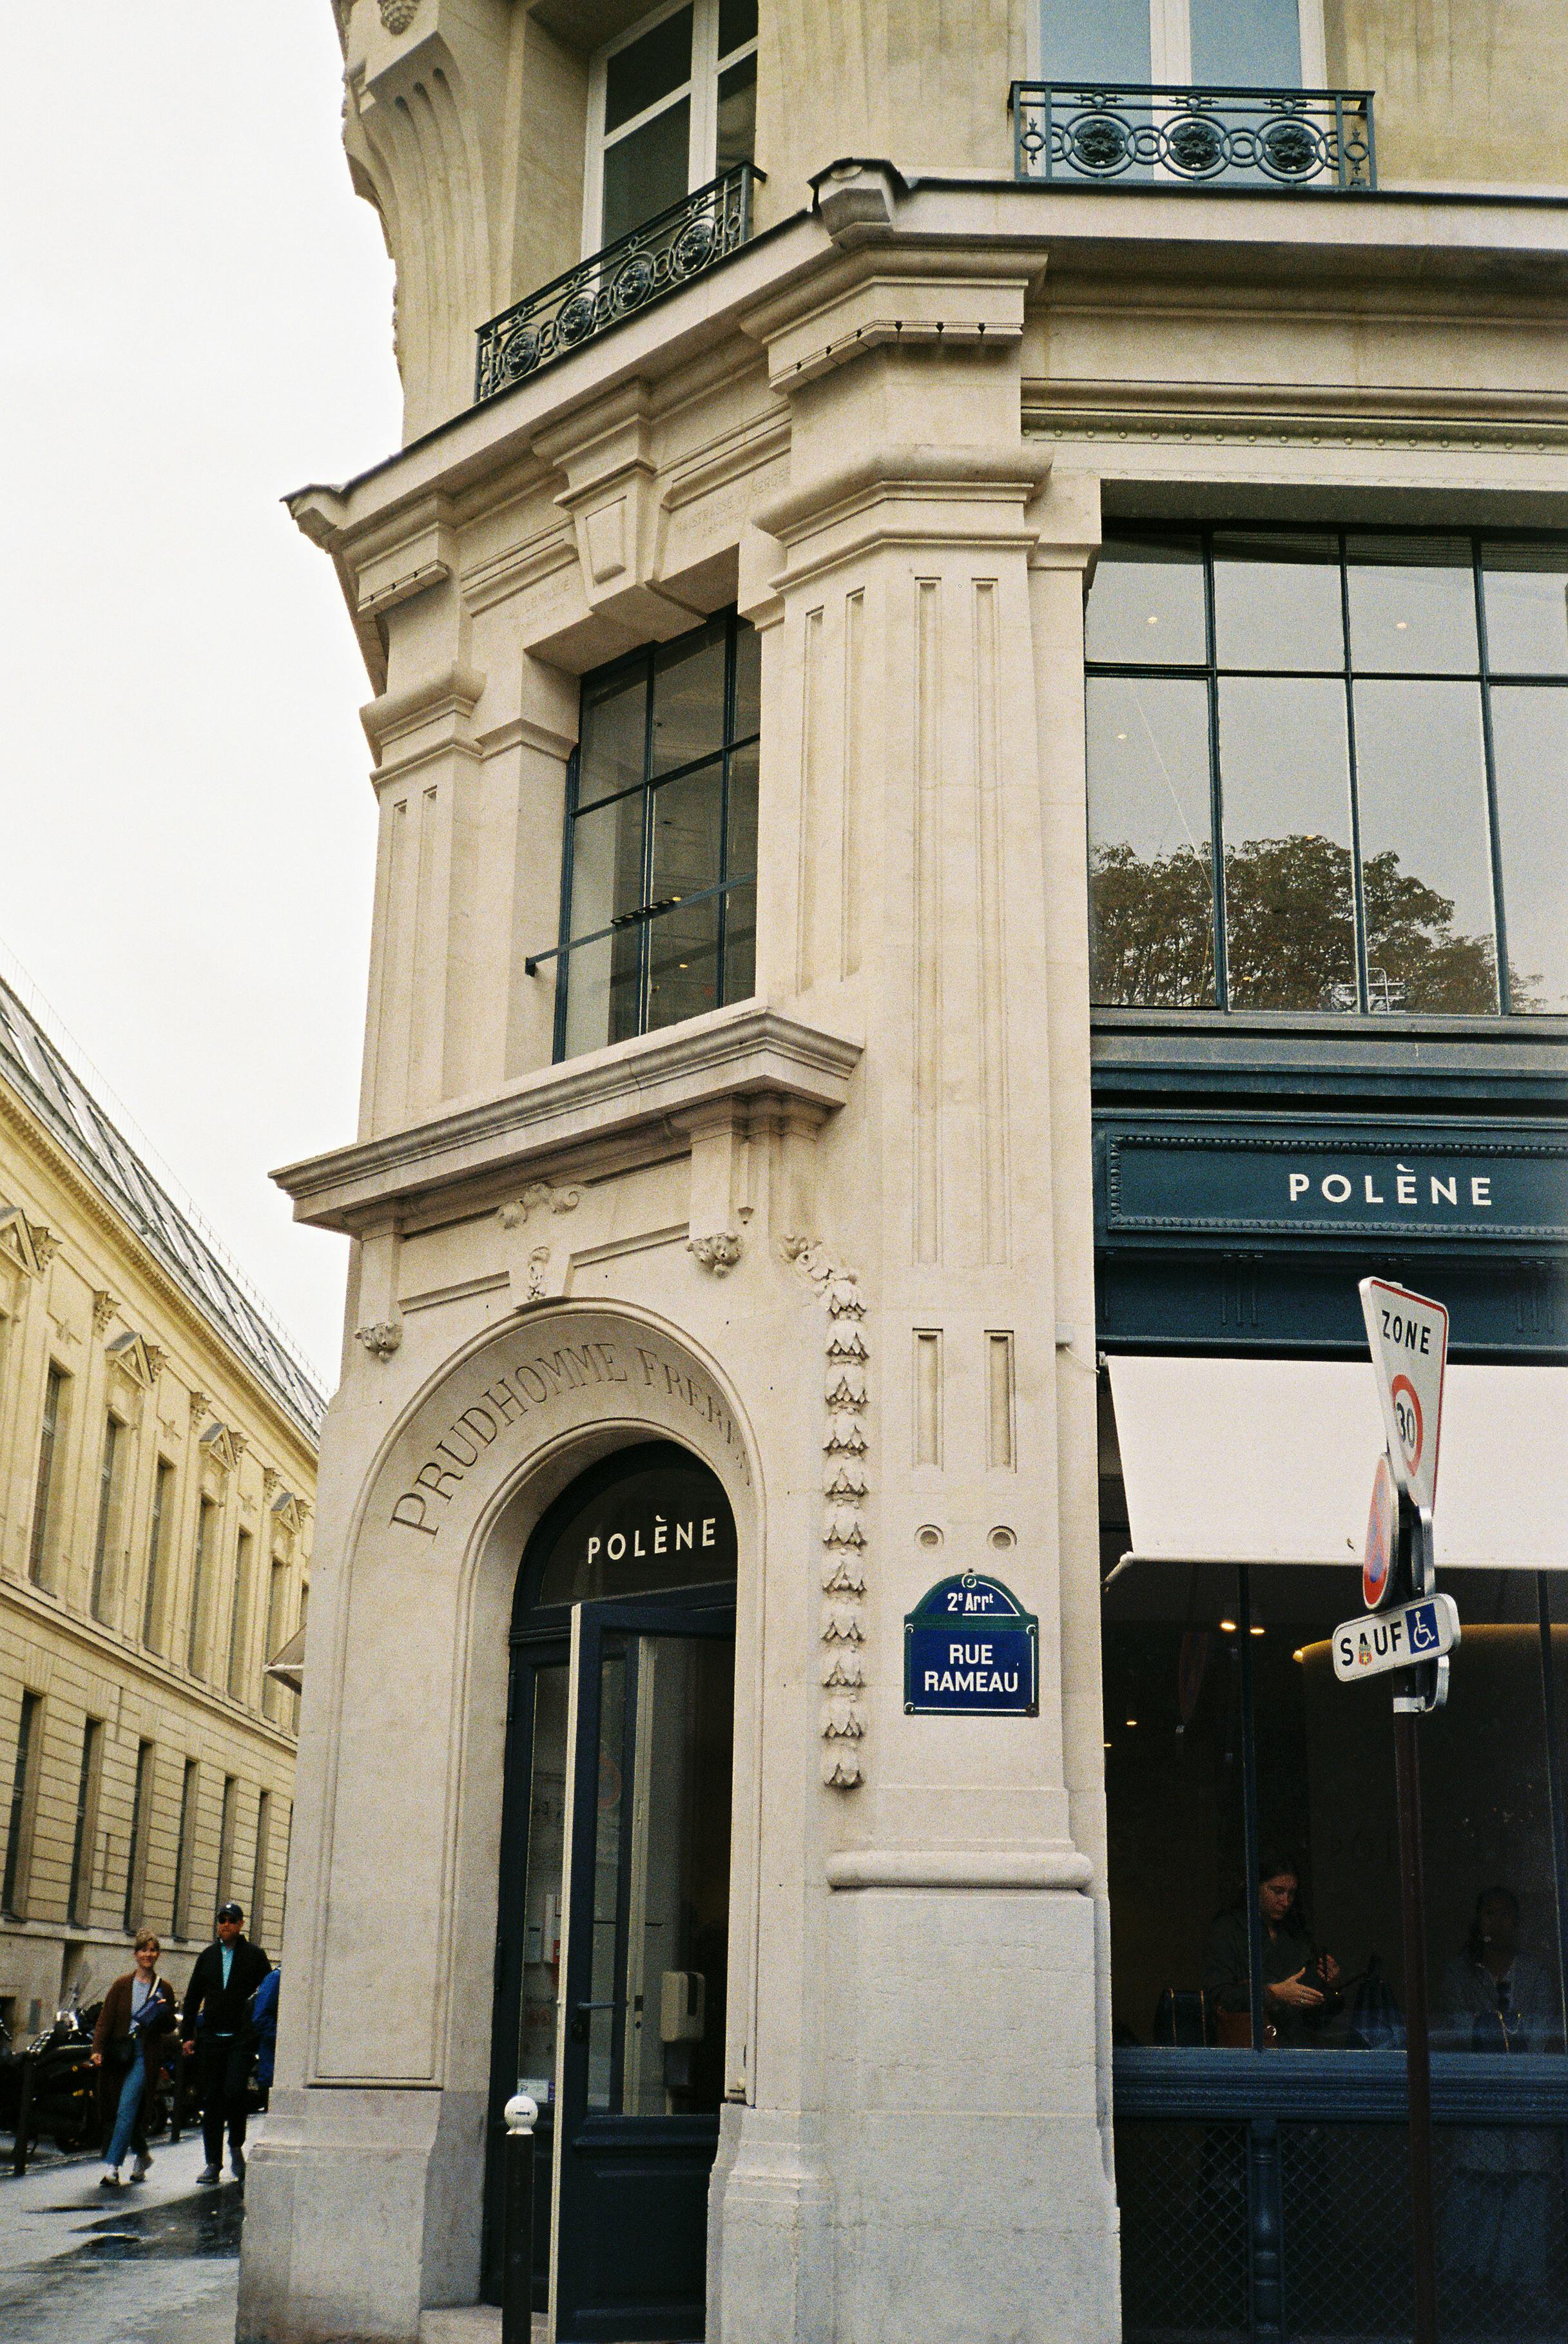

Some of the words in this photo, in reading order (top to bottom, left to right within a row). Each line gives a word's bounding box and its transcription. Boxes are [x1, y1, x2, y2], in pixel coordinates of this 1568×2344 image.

[1290, 1163, 1492, 1206] POLÈNE
[1382, 1310, 1431, 1355] ZONE
[388, 1343, 628, 1543] PRUDHOMME
[635, 1347, 751, 1486] FRER
[1397, 1401, 1415, 1449] 30
[588, 1515, 715, 1564] POLÈNE
[949, 1644, 993, 1665] RUE
[924, 1671, 1018, 1692] RAMEAU
